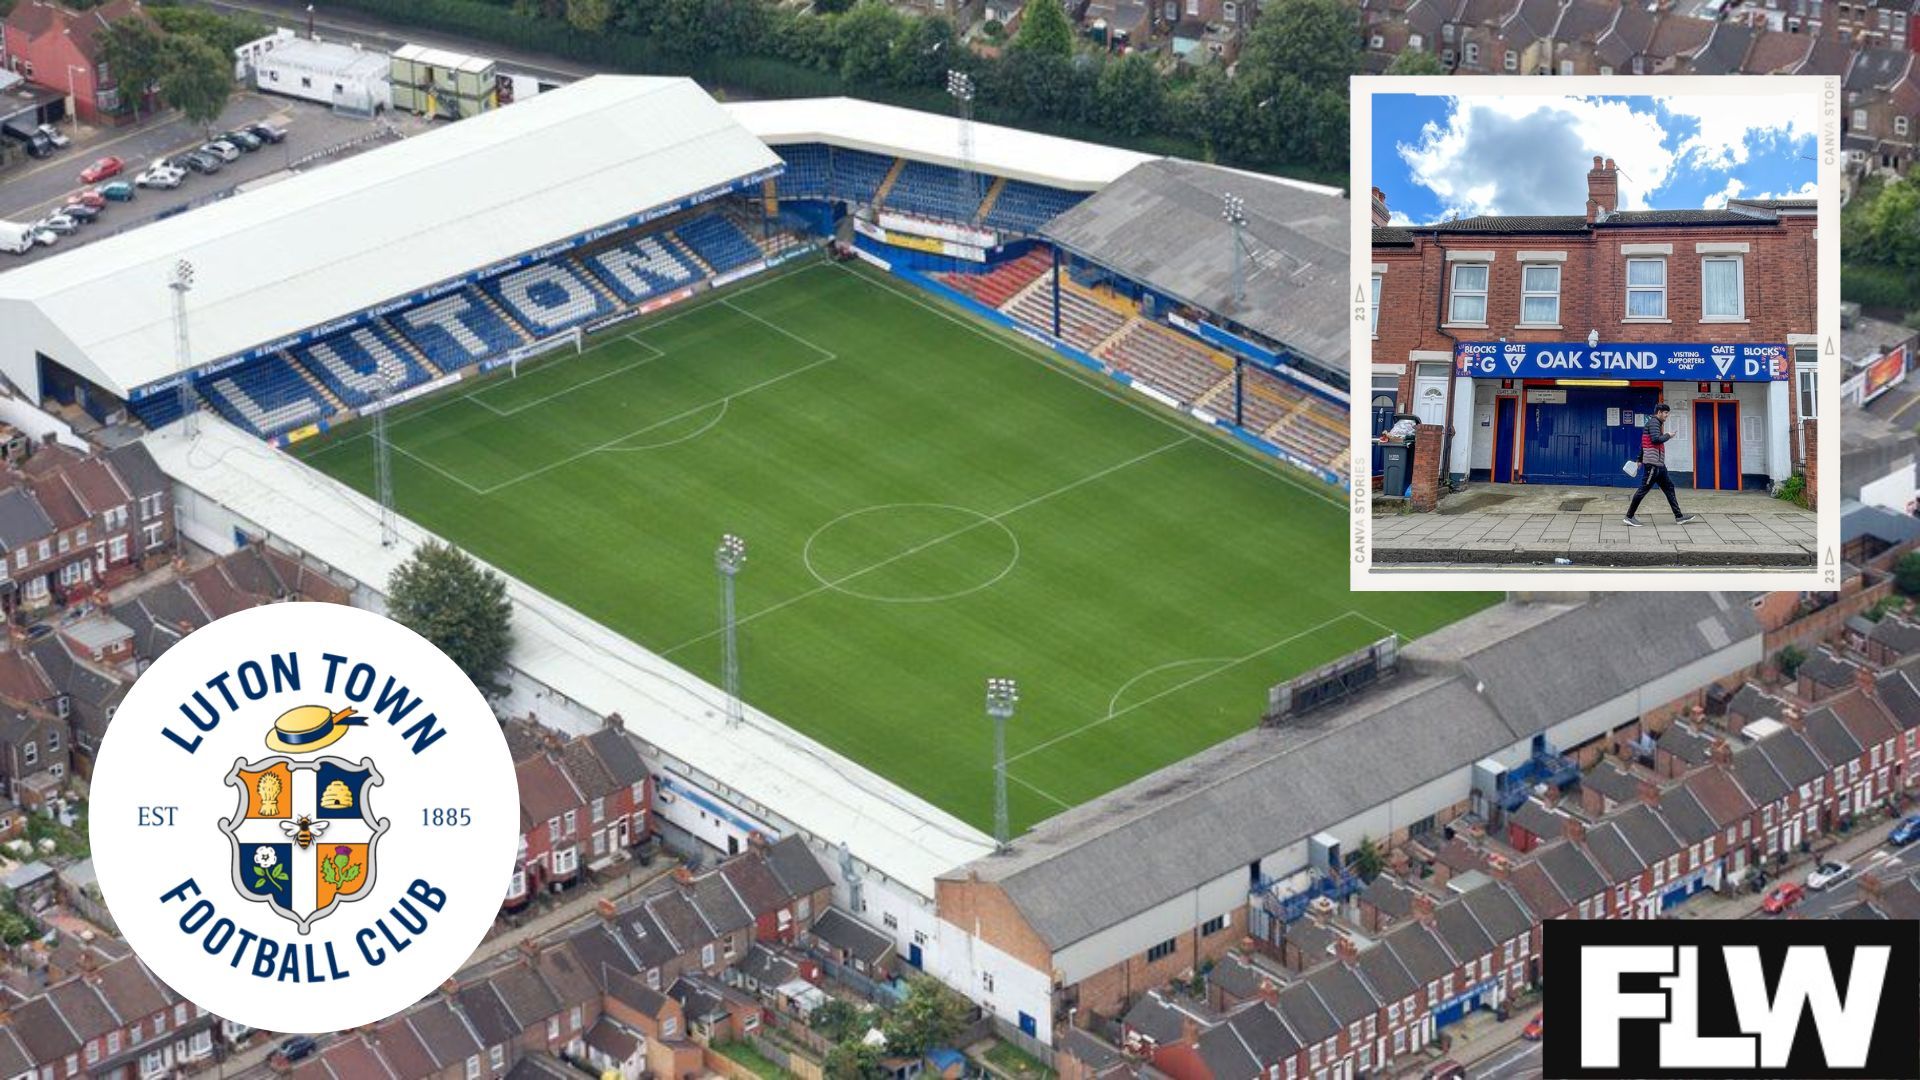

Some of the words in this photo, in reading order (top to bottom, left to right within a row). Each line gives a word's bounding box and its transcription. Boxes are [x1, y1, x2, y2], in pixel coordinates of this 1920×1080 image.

[212, 237, 691, 431] LUTON
[1464, 345, 1497, 354] BLOCKS
[1504, 344, 1526, 353] GATE
[1711, 345, 1735, 354] GATE
[1743, 347, 1780, 356] BLOCKS
[1510, 356, 1518, 367] 6
[1536, 351, 1583, 370] OAK
[1589, 351, 1658, 370] STAND
[1721, 358, 1729, 368] 7
